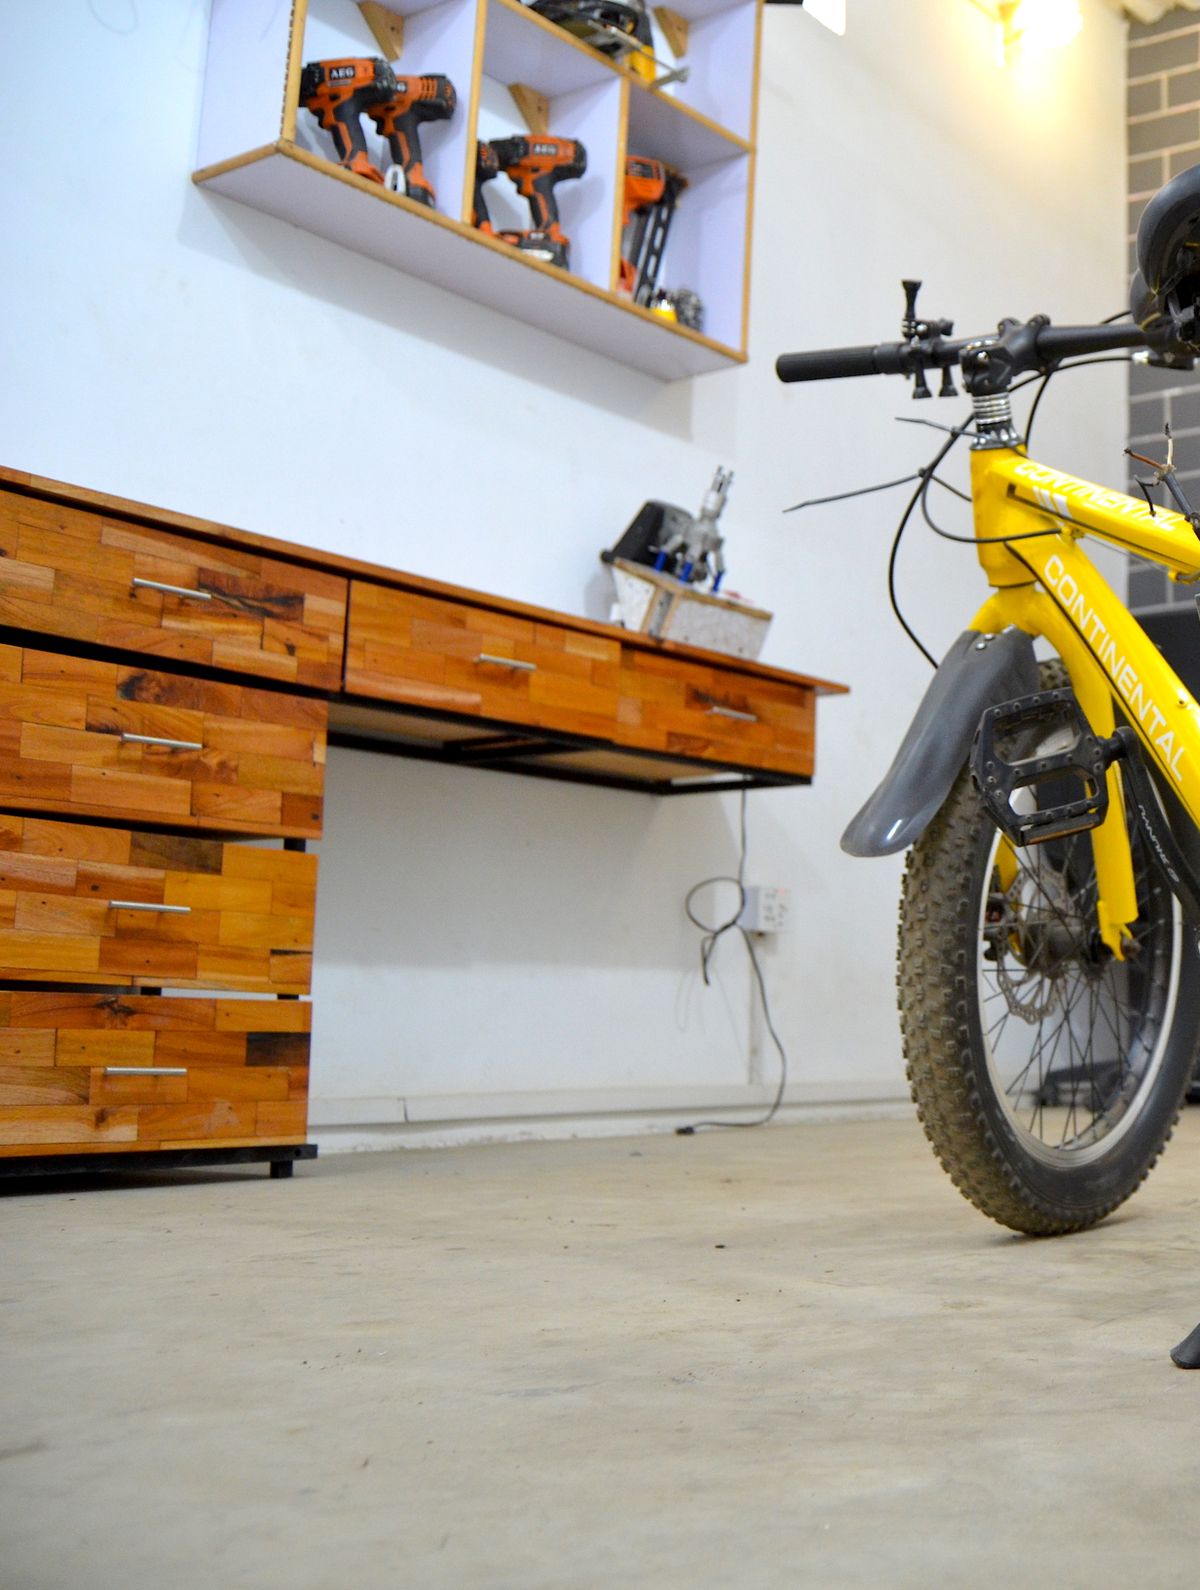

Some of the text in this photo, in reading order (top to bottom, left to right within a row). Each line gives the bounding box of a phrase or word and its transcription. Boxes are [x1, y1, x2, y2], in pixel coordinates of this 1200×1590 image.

[331, 67, 355, 80] AEG
[1014, 462, 1186, 532] CONTINENTAL
[1044, 554, 1185, 782] CONTINENTAL
